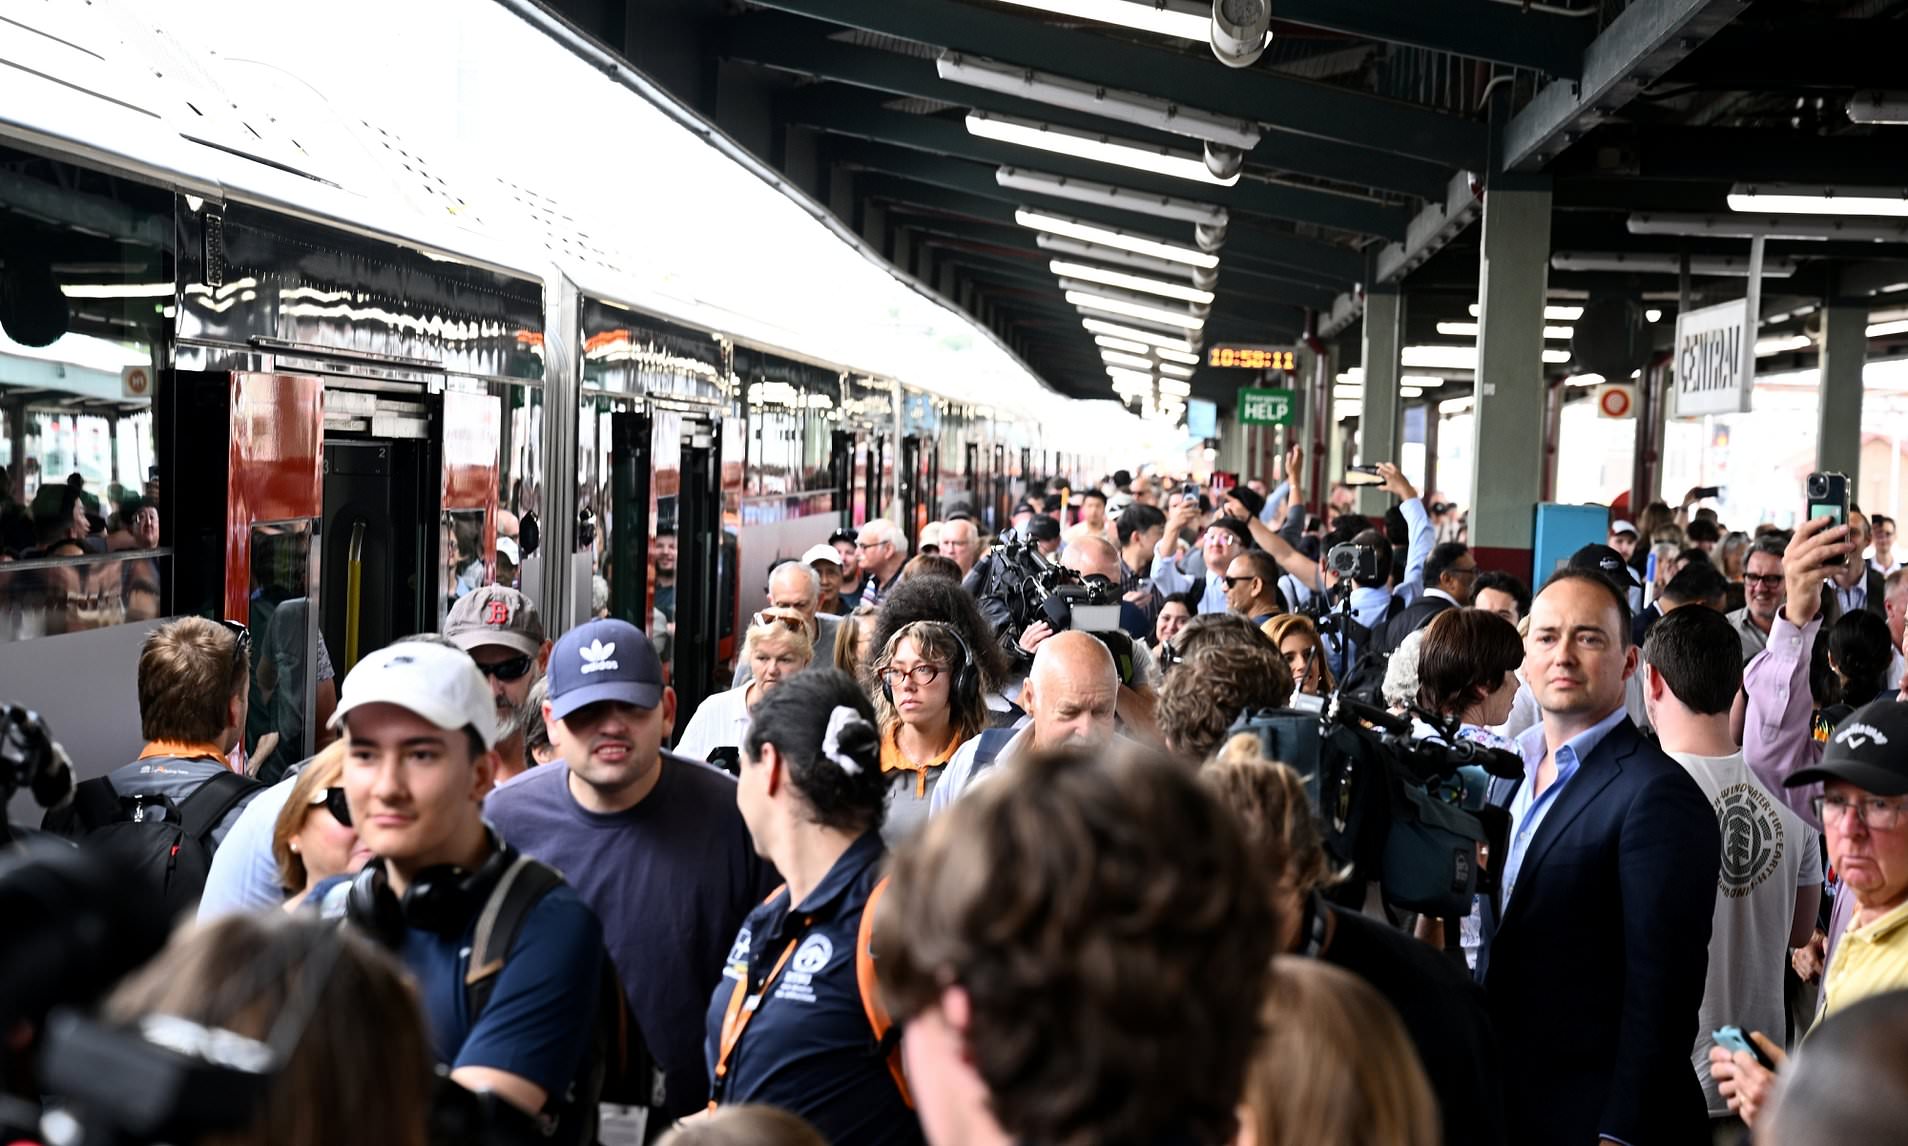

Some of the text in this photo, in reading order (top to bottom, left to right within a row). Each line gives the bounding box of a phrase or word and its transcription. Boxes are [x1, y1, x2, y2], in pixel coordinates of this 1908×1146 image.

[1244, 403, 1289, 420] HELP
[378, 447, 386, 458] 2
[486, 601, 508, 625] B
[580, 660, 618, 675] adidas
